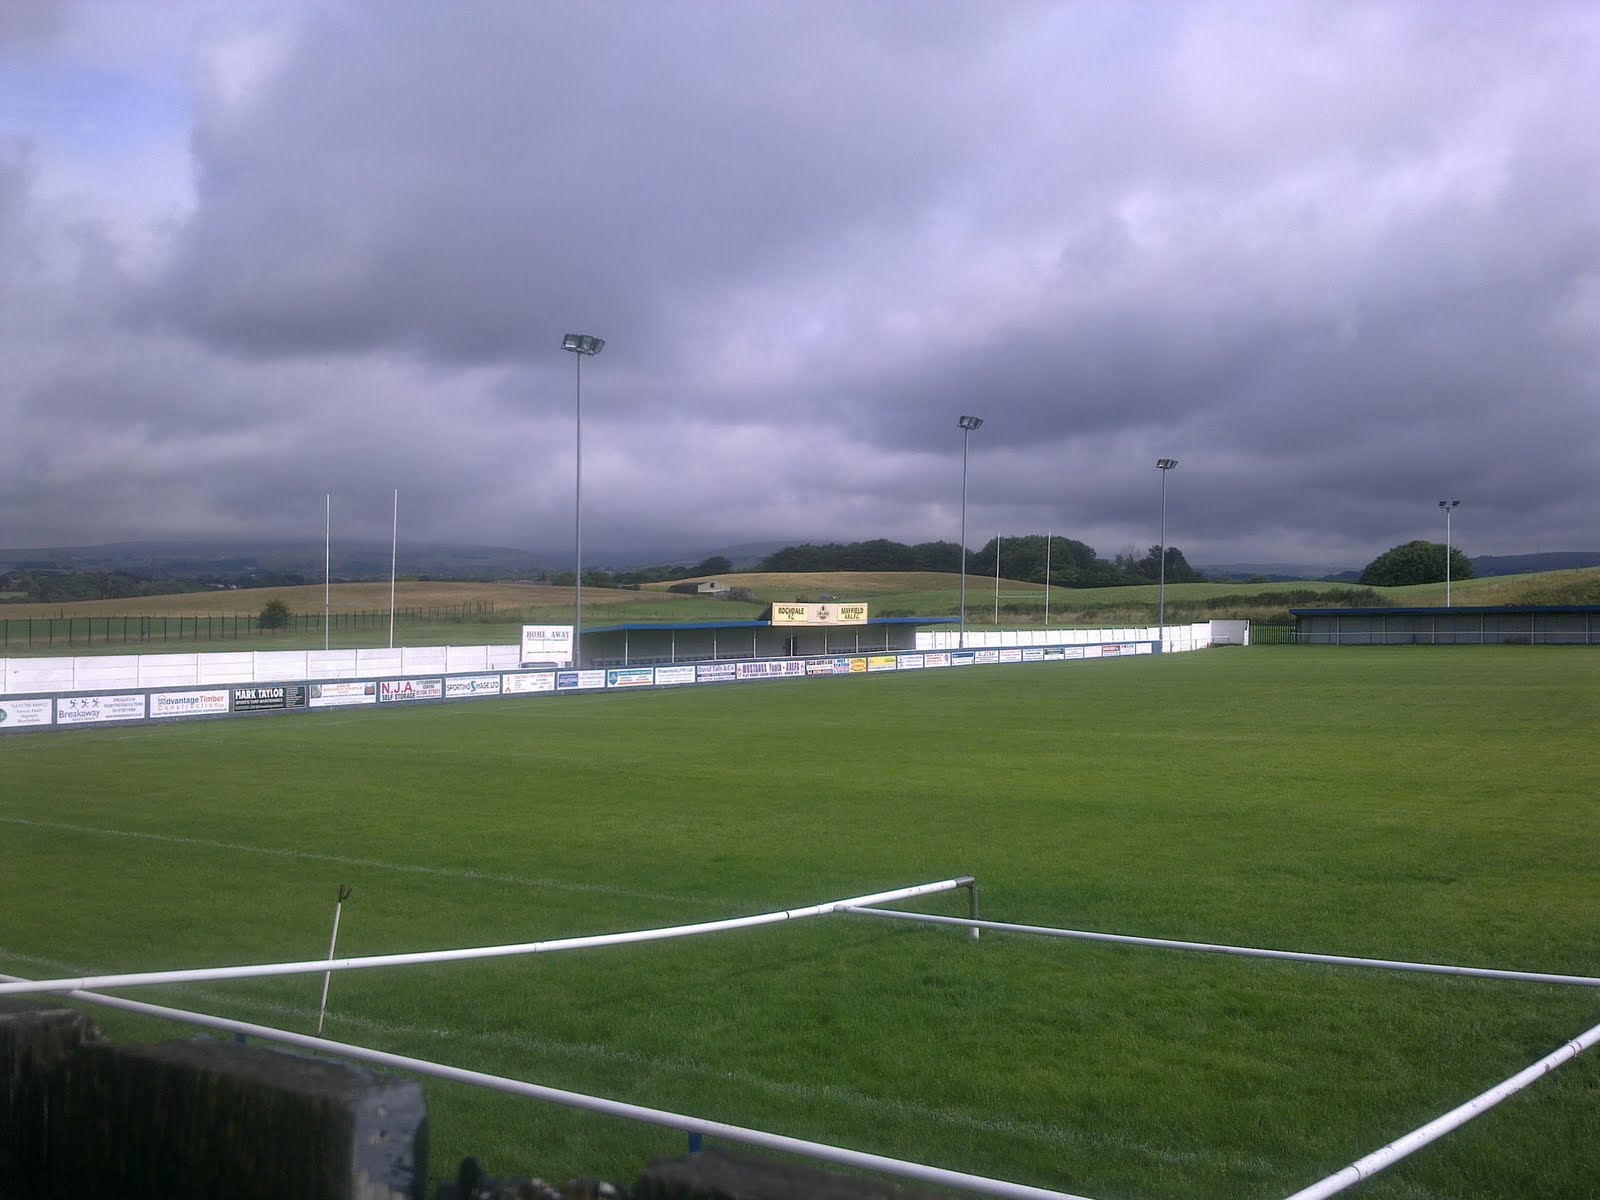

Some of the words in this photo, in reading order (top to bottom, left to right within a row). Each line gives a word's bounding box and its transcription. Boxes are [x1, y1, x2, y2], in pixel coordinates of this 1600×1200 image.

[778, 607, 805, 615] ROCHDALE
[841, 607, 864, 615] MAYFIELD
[381, 681, 416, 694] N.J.A.
[447, 683, 471, 692] SPORTING
[235, 689, 257, 699] MARK
[257, 688, 284, 698] TAYLOR
[200, 695, 224, 703] Timber
[158, 702, 218, 711] Construction
[59, 709, 100, 718] Breakaway
